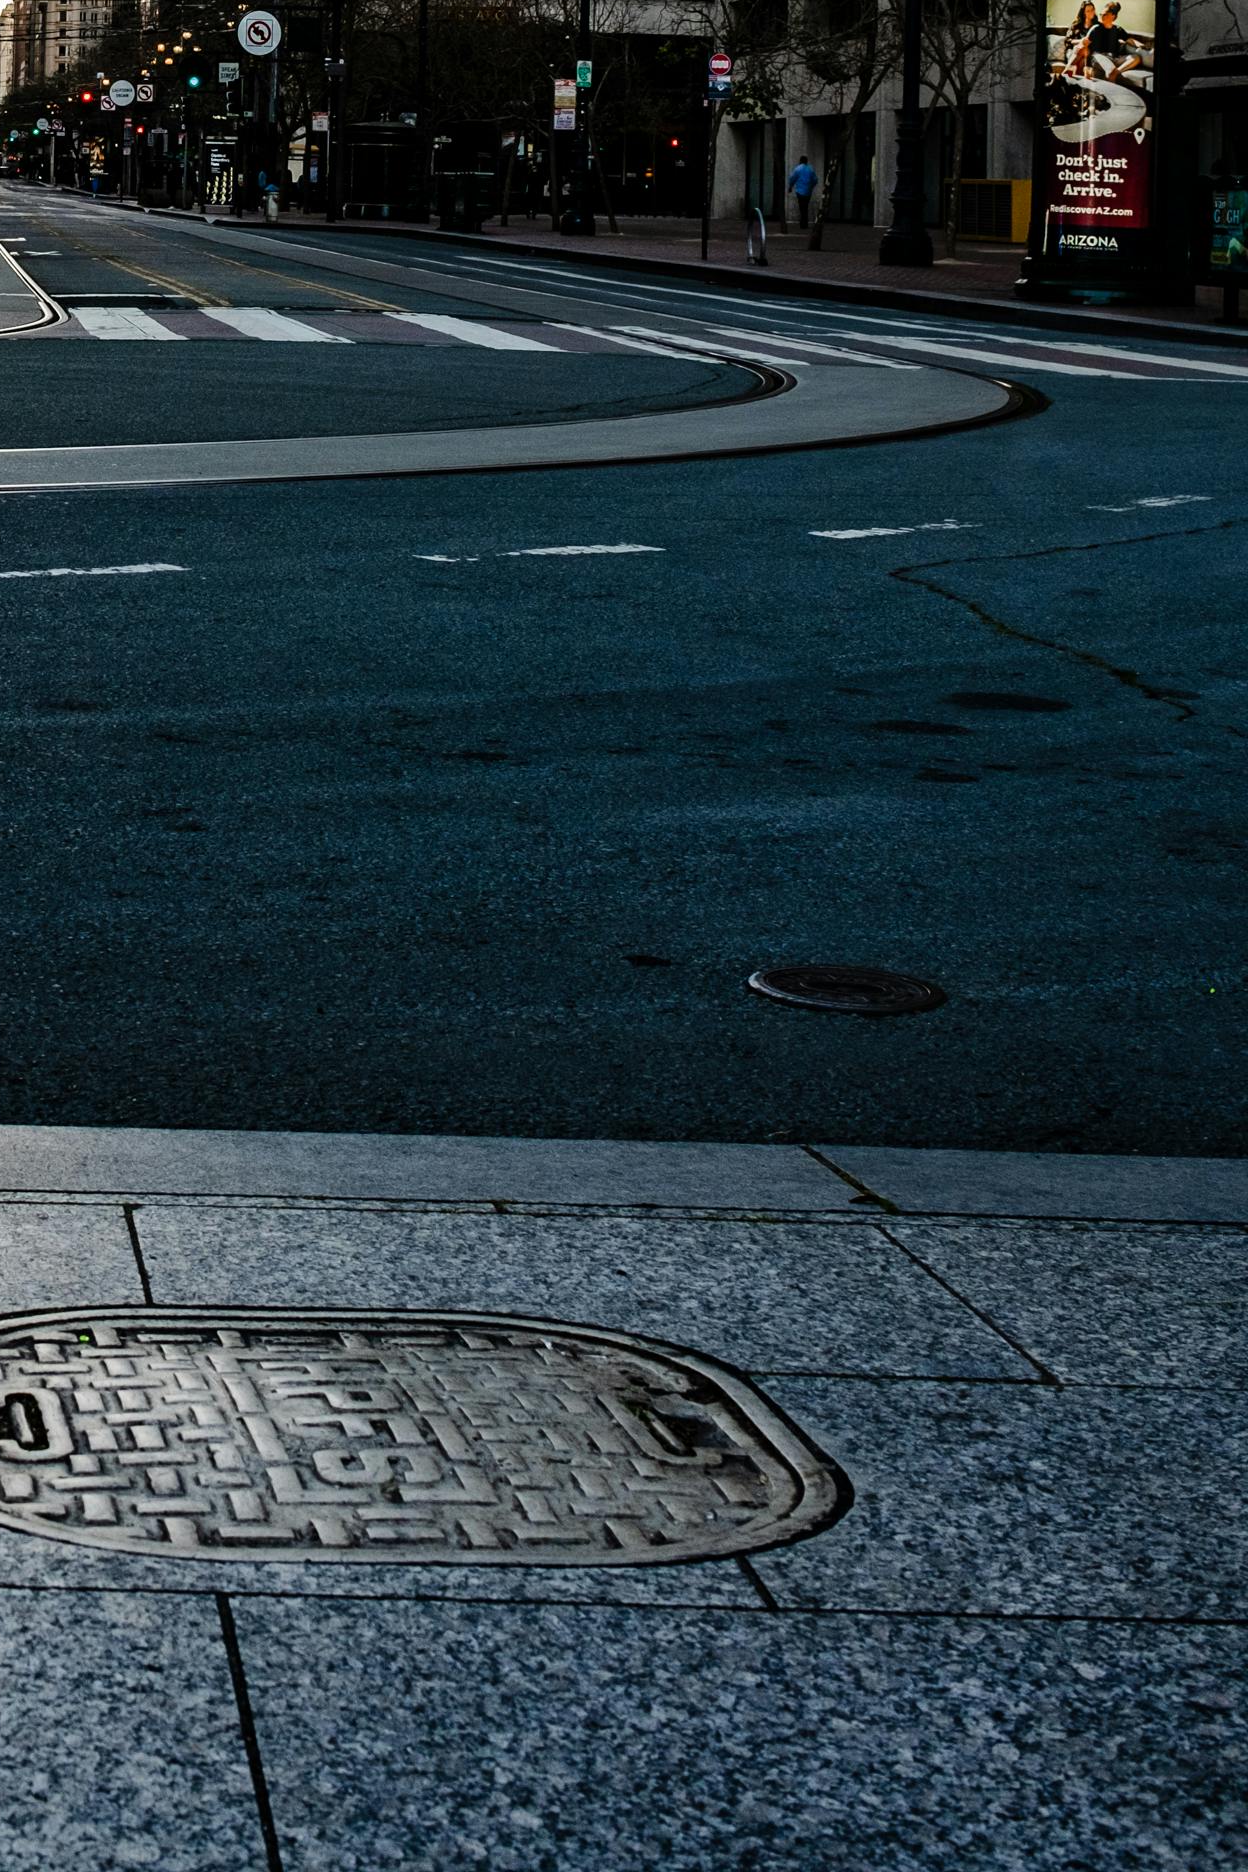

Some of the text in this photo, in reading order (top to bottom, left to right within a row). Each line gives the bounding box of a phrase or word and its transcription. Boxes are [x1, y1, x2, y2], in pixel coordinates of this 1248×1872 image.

[1056, 154, 1128, 171] Don't just
[1058, 169, 1125, 183] check in.
[1063, 184, 1117, 198] Arrive.
[1050, 204, 1133, 216] RediscoverAZ.com
[1059, 234, 1118, 248] ARIZONA
